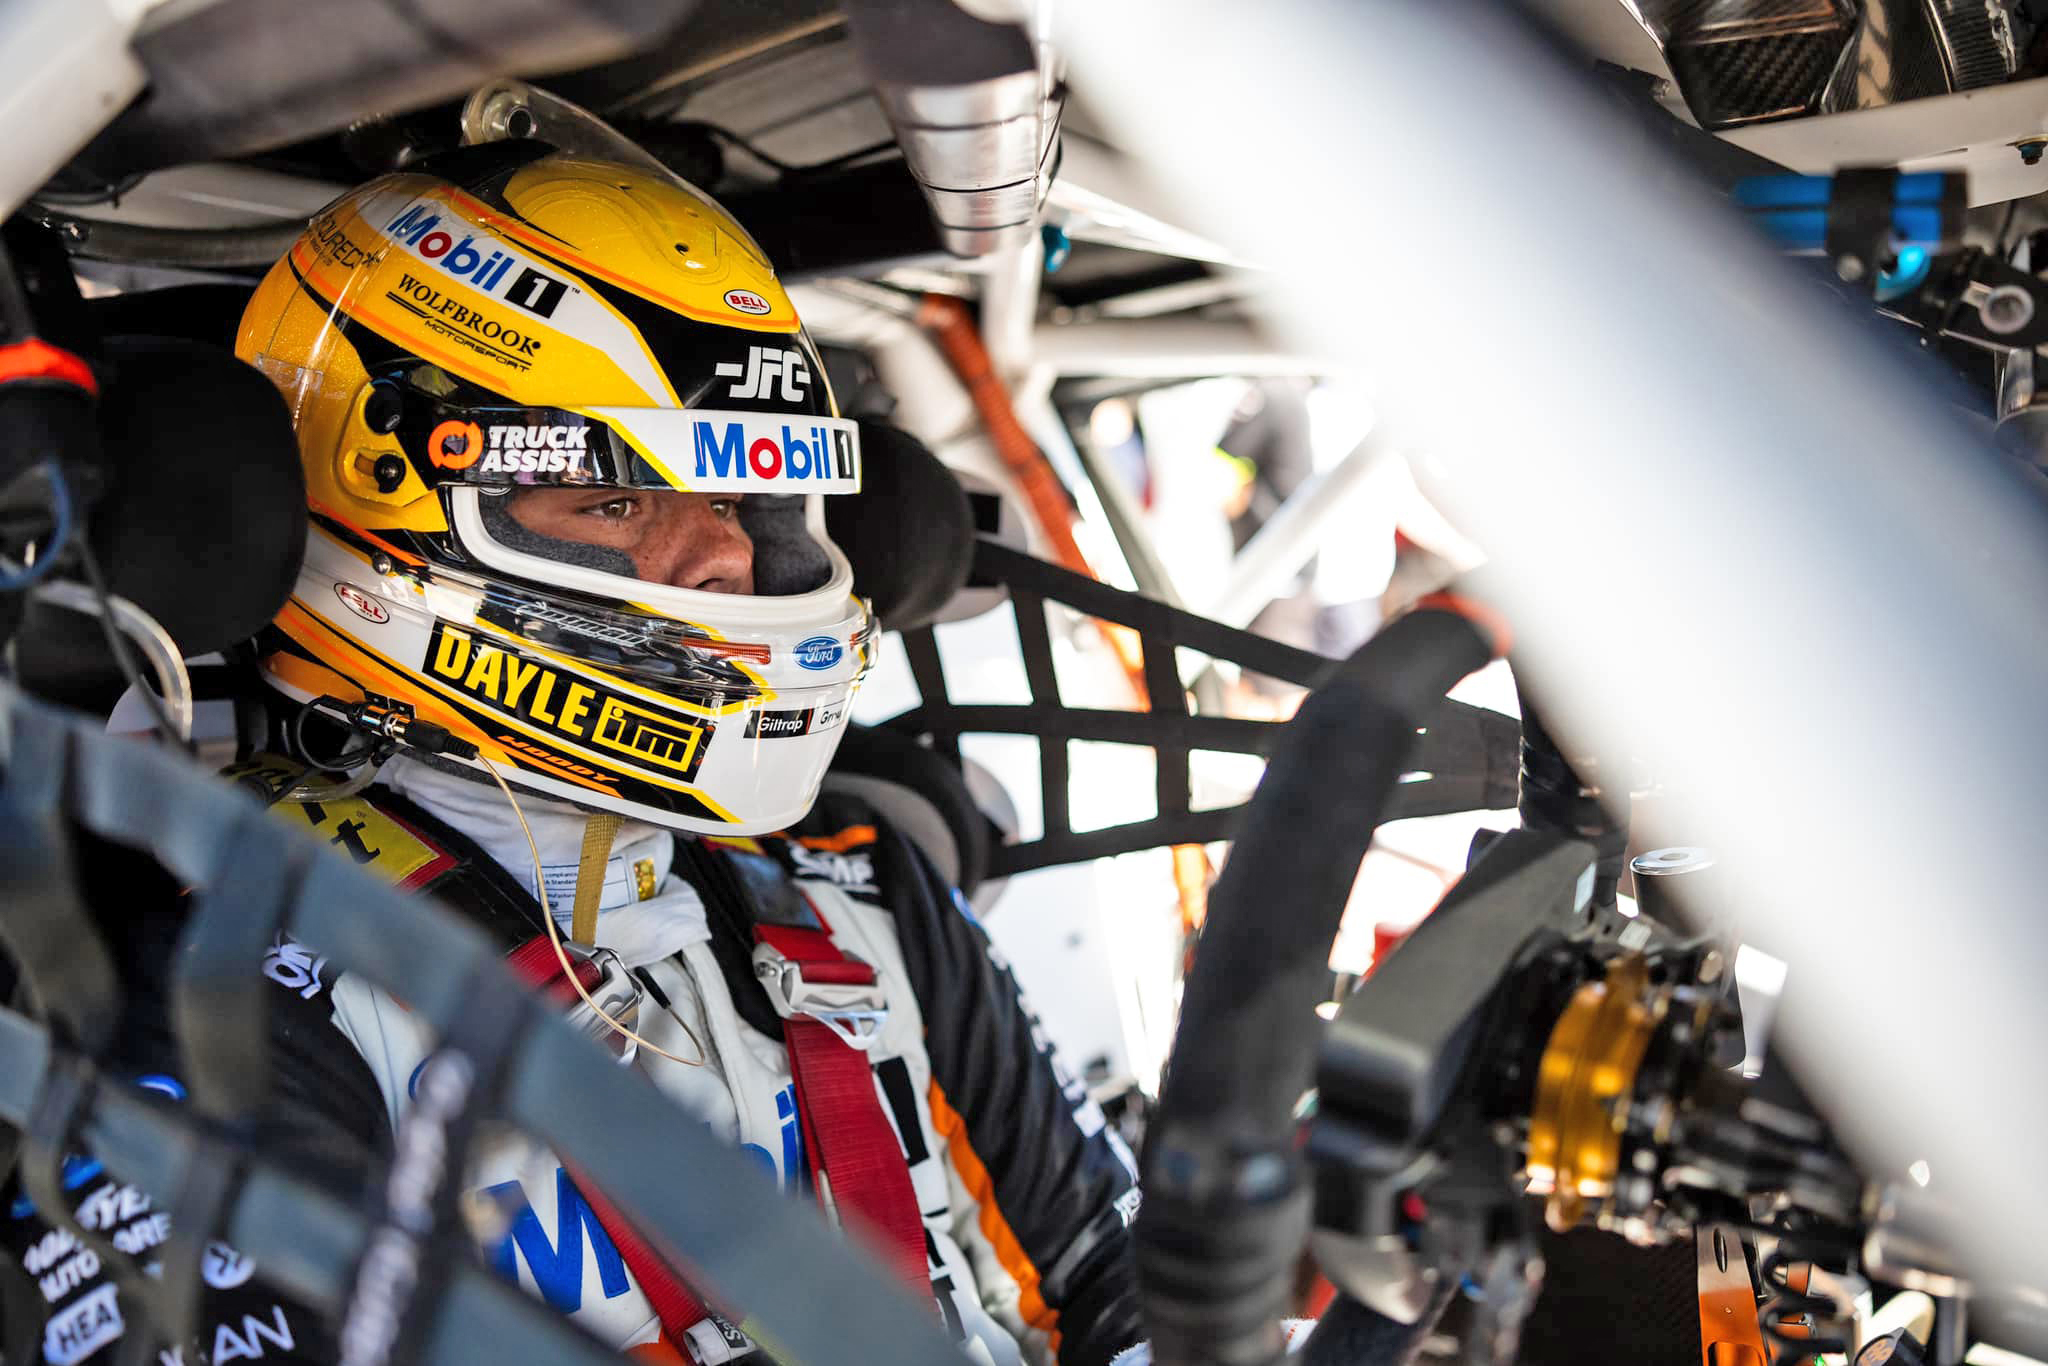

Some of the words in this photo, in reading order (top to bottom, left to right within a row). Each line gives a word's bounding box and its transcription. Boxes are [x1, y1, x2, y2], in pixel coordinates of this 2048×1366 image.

[387, 204, 515, 292] Mobil
[398, 273, 537, 357] WOLFBROOK
[729, 294, 768, 309] BELL
[424, 320, 531, 373] MOTORSPORT
[480, 450, 586, 473] ASSIST
[489, 426, 591, 449] TRUCK
[693, 421, 832, 480] Mobil
[434, 625, 596, 737] DAYLE
[759, 717, 804, 734] Giltrap
